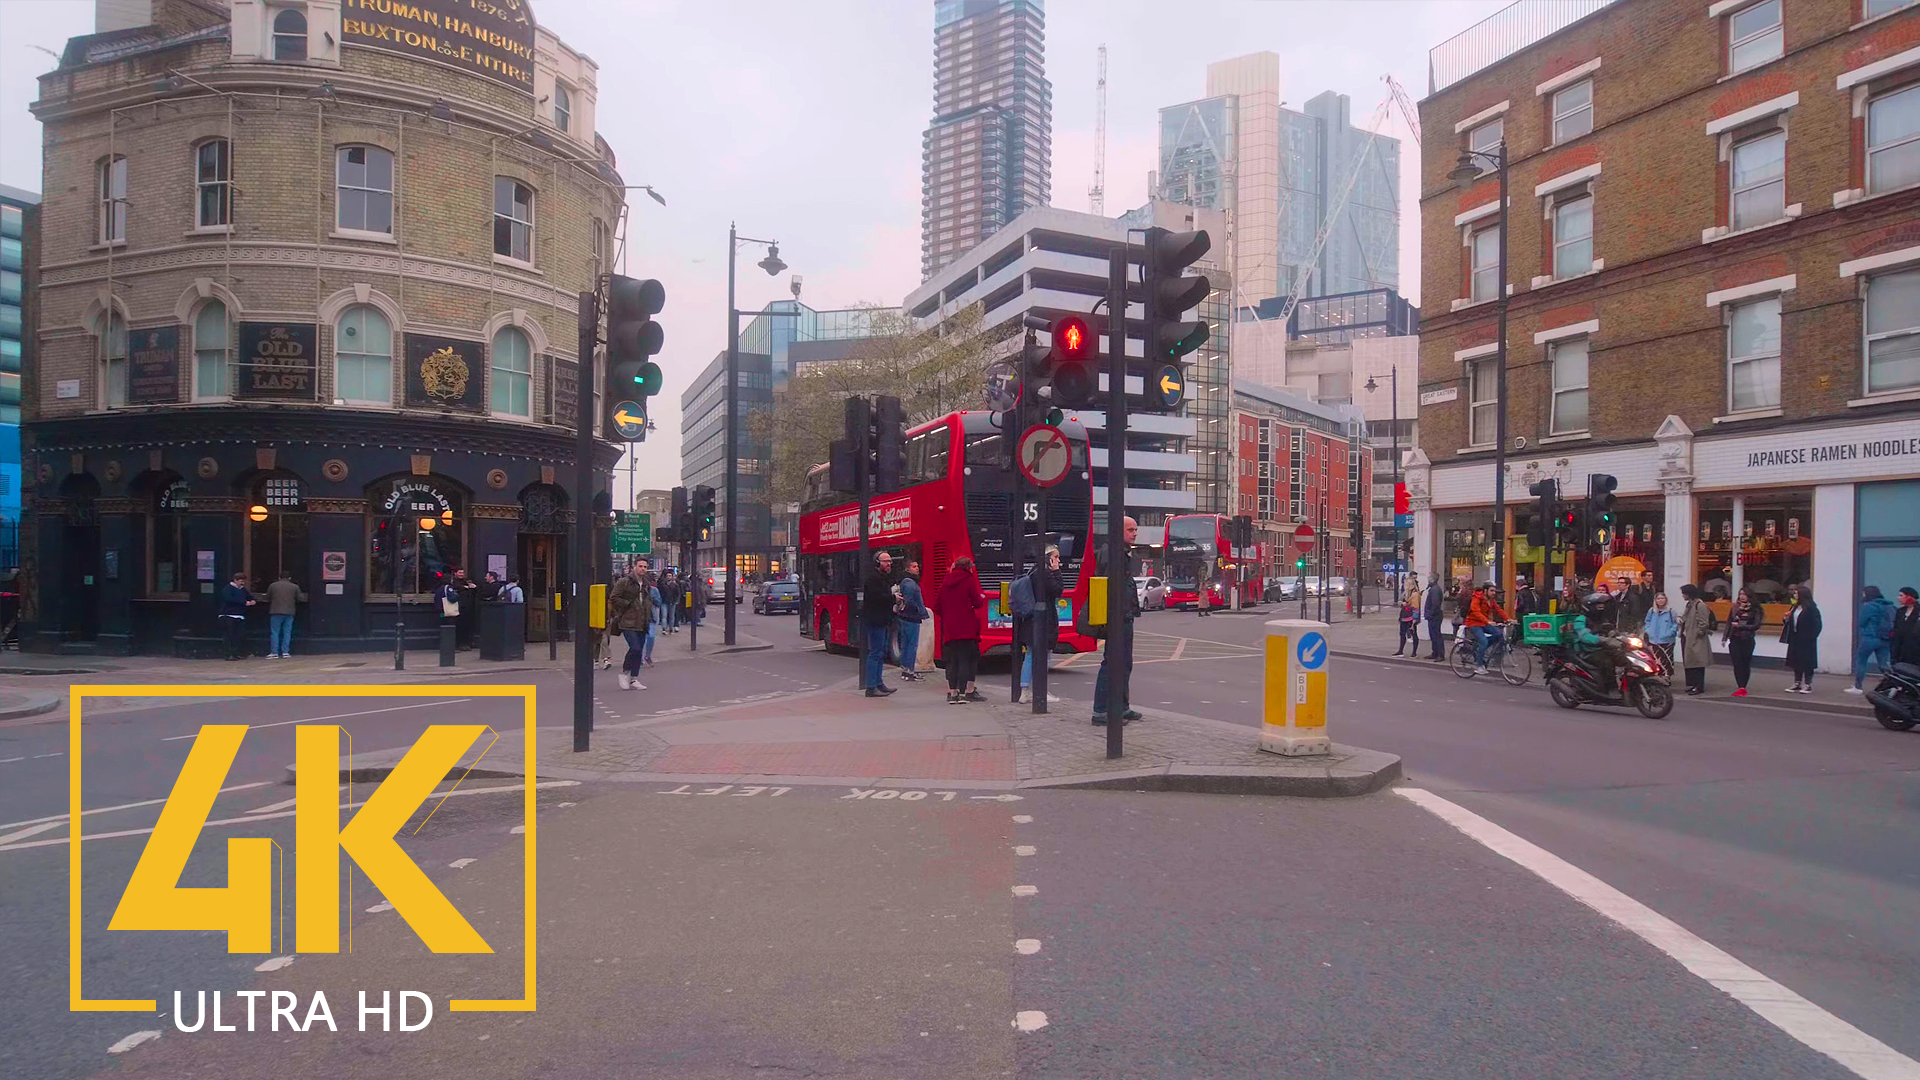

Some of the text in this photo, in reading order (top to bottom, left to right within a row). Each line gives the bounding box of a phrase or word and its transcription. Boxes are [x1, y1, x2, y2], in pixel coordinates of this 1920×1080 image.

[343, 17, 436, 52] BUXTON
[257, 340, 303, 356] OLD
[251, 357, 309, 373] BLUE
[252, 374, 309, 390] LAST
[1422, 388, 1456, 399] GREAT EASTERN
[1747, 448, 1806, 468] JAPANESE
[1811, 444, 1857, 463] RAMEN
[266, 479, 298, 487] BEER
[266, 488, 298, 496] BEER
[384, 483, 451, 512] OLD BLUE LAST
[266, 497, 298, 505] BEER
[411, 502, 435, 511] EER
[883, 507, 910, 522] Jet2.com
[1202, 543, 1212, 551] 35
[656, 785, 957, 801] LOOK LEFT
